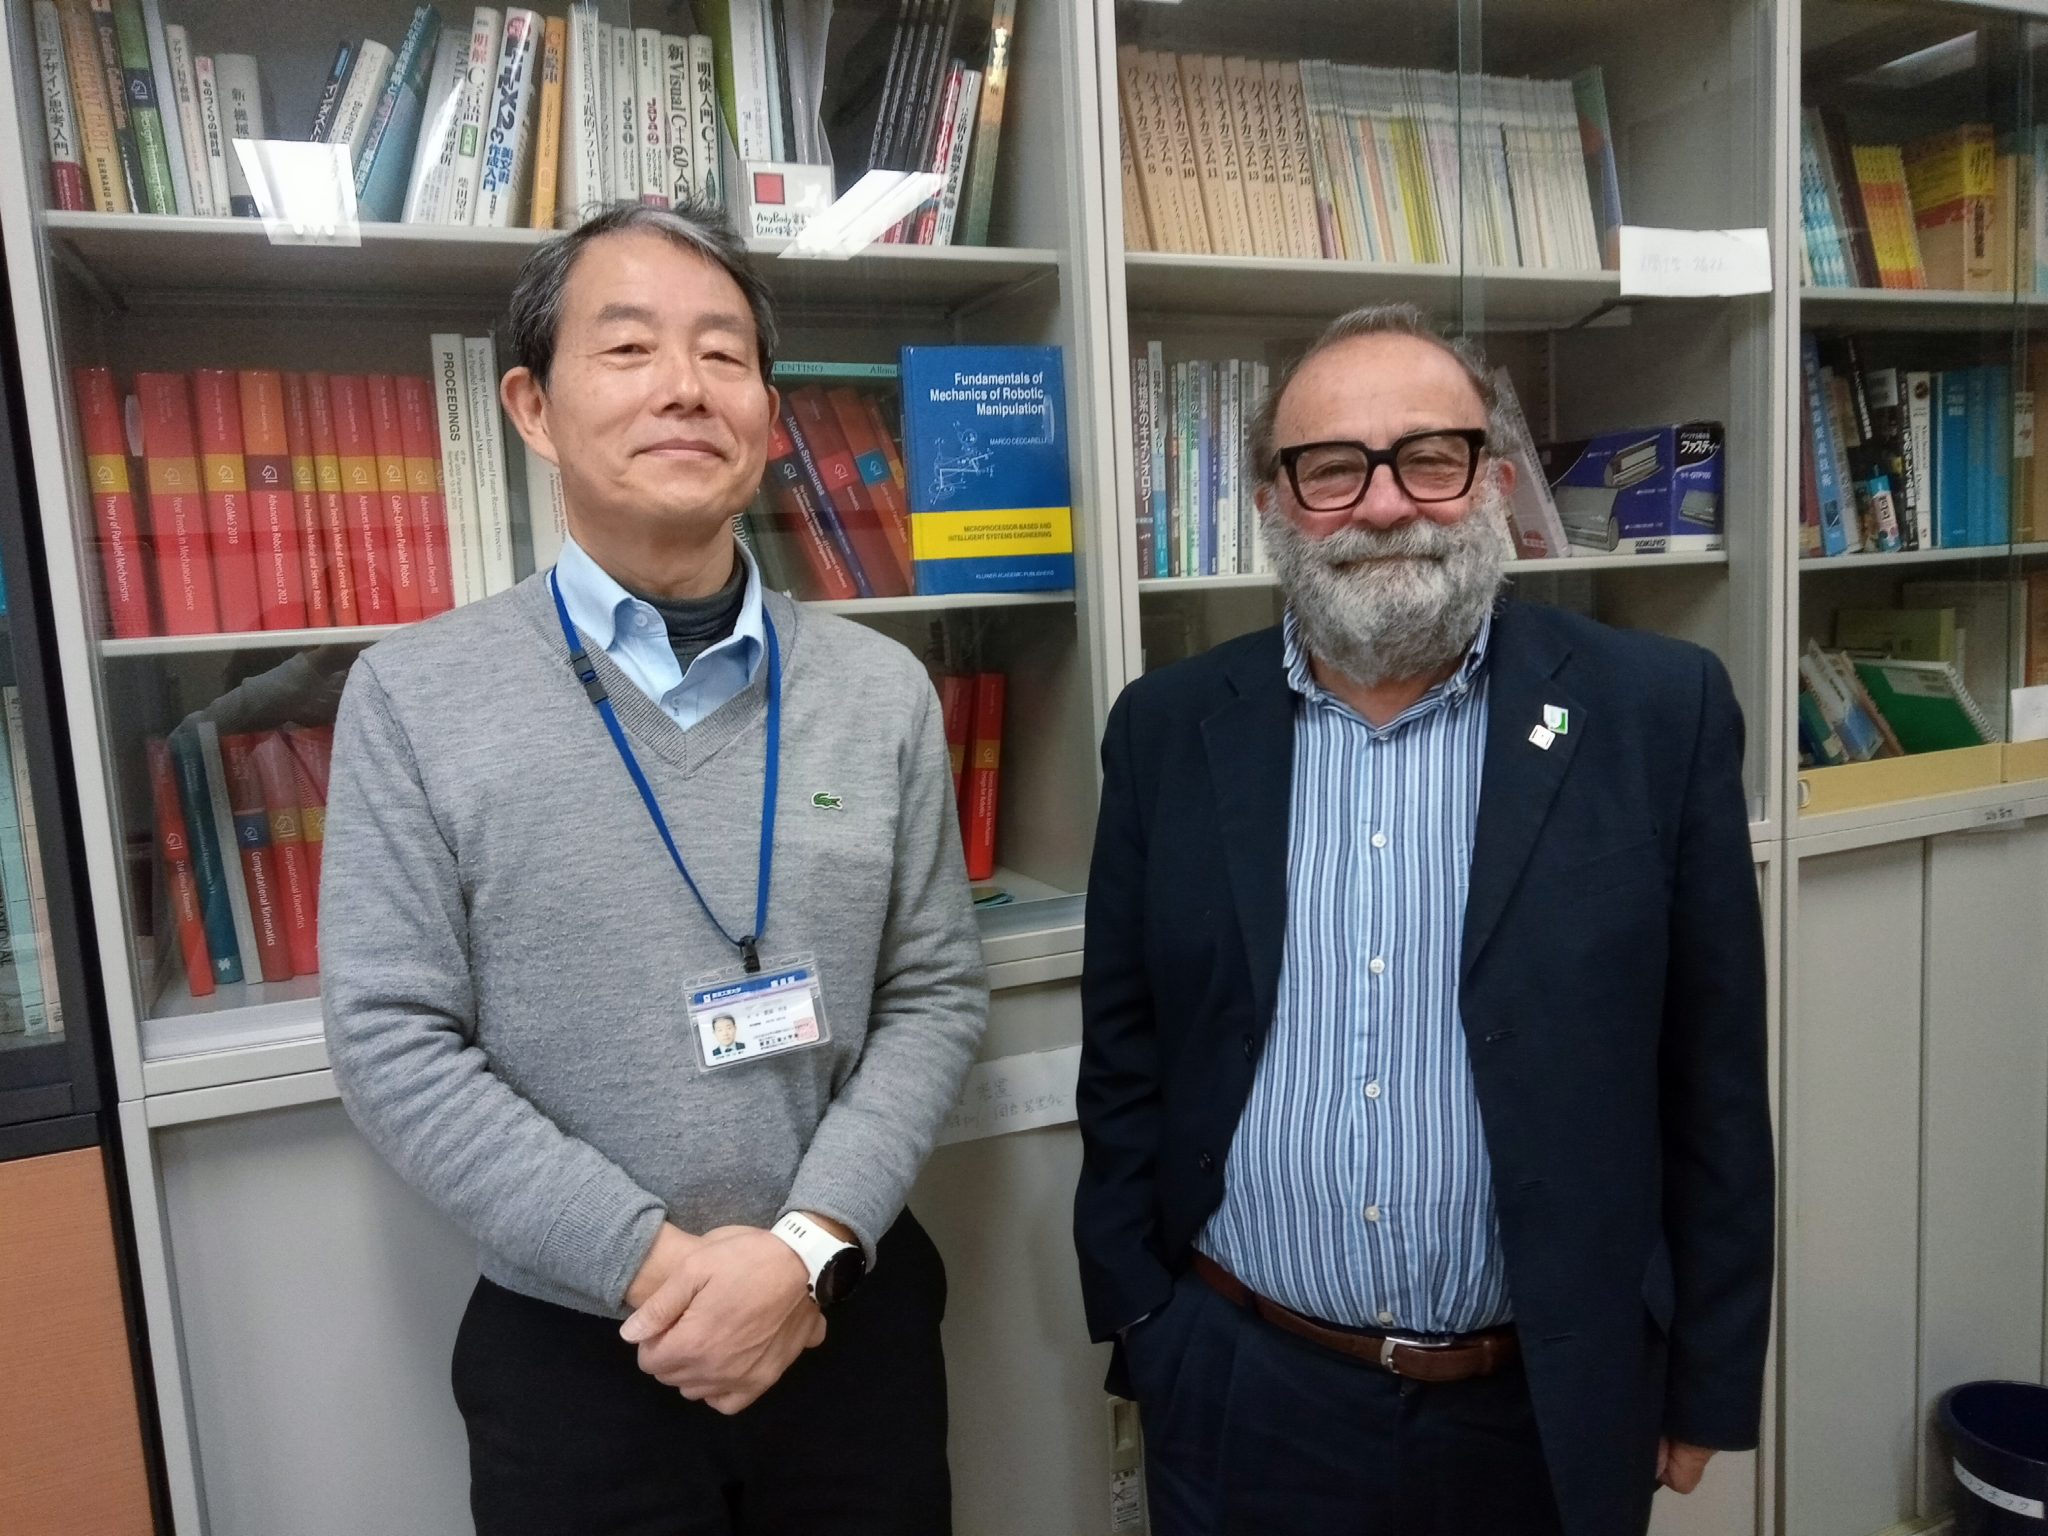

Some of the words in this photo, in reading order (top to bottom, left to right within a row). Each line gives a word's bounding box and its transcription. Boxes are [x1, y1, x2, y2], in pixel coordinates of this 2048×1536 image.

[97, 157, 112, 197] BERNARD
[955, 373, 1030, 385] Fundamentals
[1032, 372, 1043, 384] of
[442, 351, 461, 441] PROCEEDINGS
[931, 389, 987, 402] Mechanics
[990, 388, 1001, 400] of
[1003, 388, 1044, 399] Robotic
[977, 403, 1045, 417] Manipulation
[480, 393, 493, 437] Fundamental
[488, 472, 498, 493] Future
[1137, 358, 1151, 514] 筋骨格系のキネシオロジー
[785, 415, 804, 449] Motion
[800, 447, 825, 496] Structures
[104, 495, 118, 521] Theory
[172, 496, 183, 513] New
[222, 493, 238, 527] EuCoMeS
[266, 494, 279, 524] Advances
[303, 494, 312, 507] New
[327, 493, 337, 507] New
[358, 493, 370, 523] Advances
[109, 520, 120, 530] of
[175, 513, 187, 535] Trends
[391, 494, 405, 537] Cable-Driven
[1040, 522, 1052, 530] AND
[110, 529, 124, 557] Parallel
[178, 536, 187, 544] in
[226, 526, 240, 545] 2018
[271, 532, 282, 552] Robot
[332, 532, 344, 556] Medical
[363, 530, 373, 550] Italian
[948, 533, 985, 541] INTELLIGENT
[986, 532, 1013, 540] SYSTEMS
[1014, 531, 1052, 540] ENGINEERING
[1635, 539, 1666, 547] KOKUYO
[396, 537, 408, 562] Parallel
[178, 544, 193, 584] Mechanism
[309, 556, 318, 569] and
[335, 556, 345, 568] and
[365, 550, 379, 586] Mechanism
[114, 557, 131, 602] Mechanisms
[310, 568, 320, 589] Service
[337, 568, 348, 589] Service
[399, 562, 410, 587] Robots
[276, 588, 288, 605] 2022
[339, 589, 350, 609] Robots
[370, 586, 381, 609] Science
[250, 850, 269, 905] Computational
[261, 905, 276, 946] Kinematics
[282, 845, 301, 892] Computational
[292, 892, 307, 929] Kinematics
